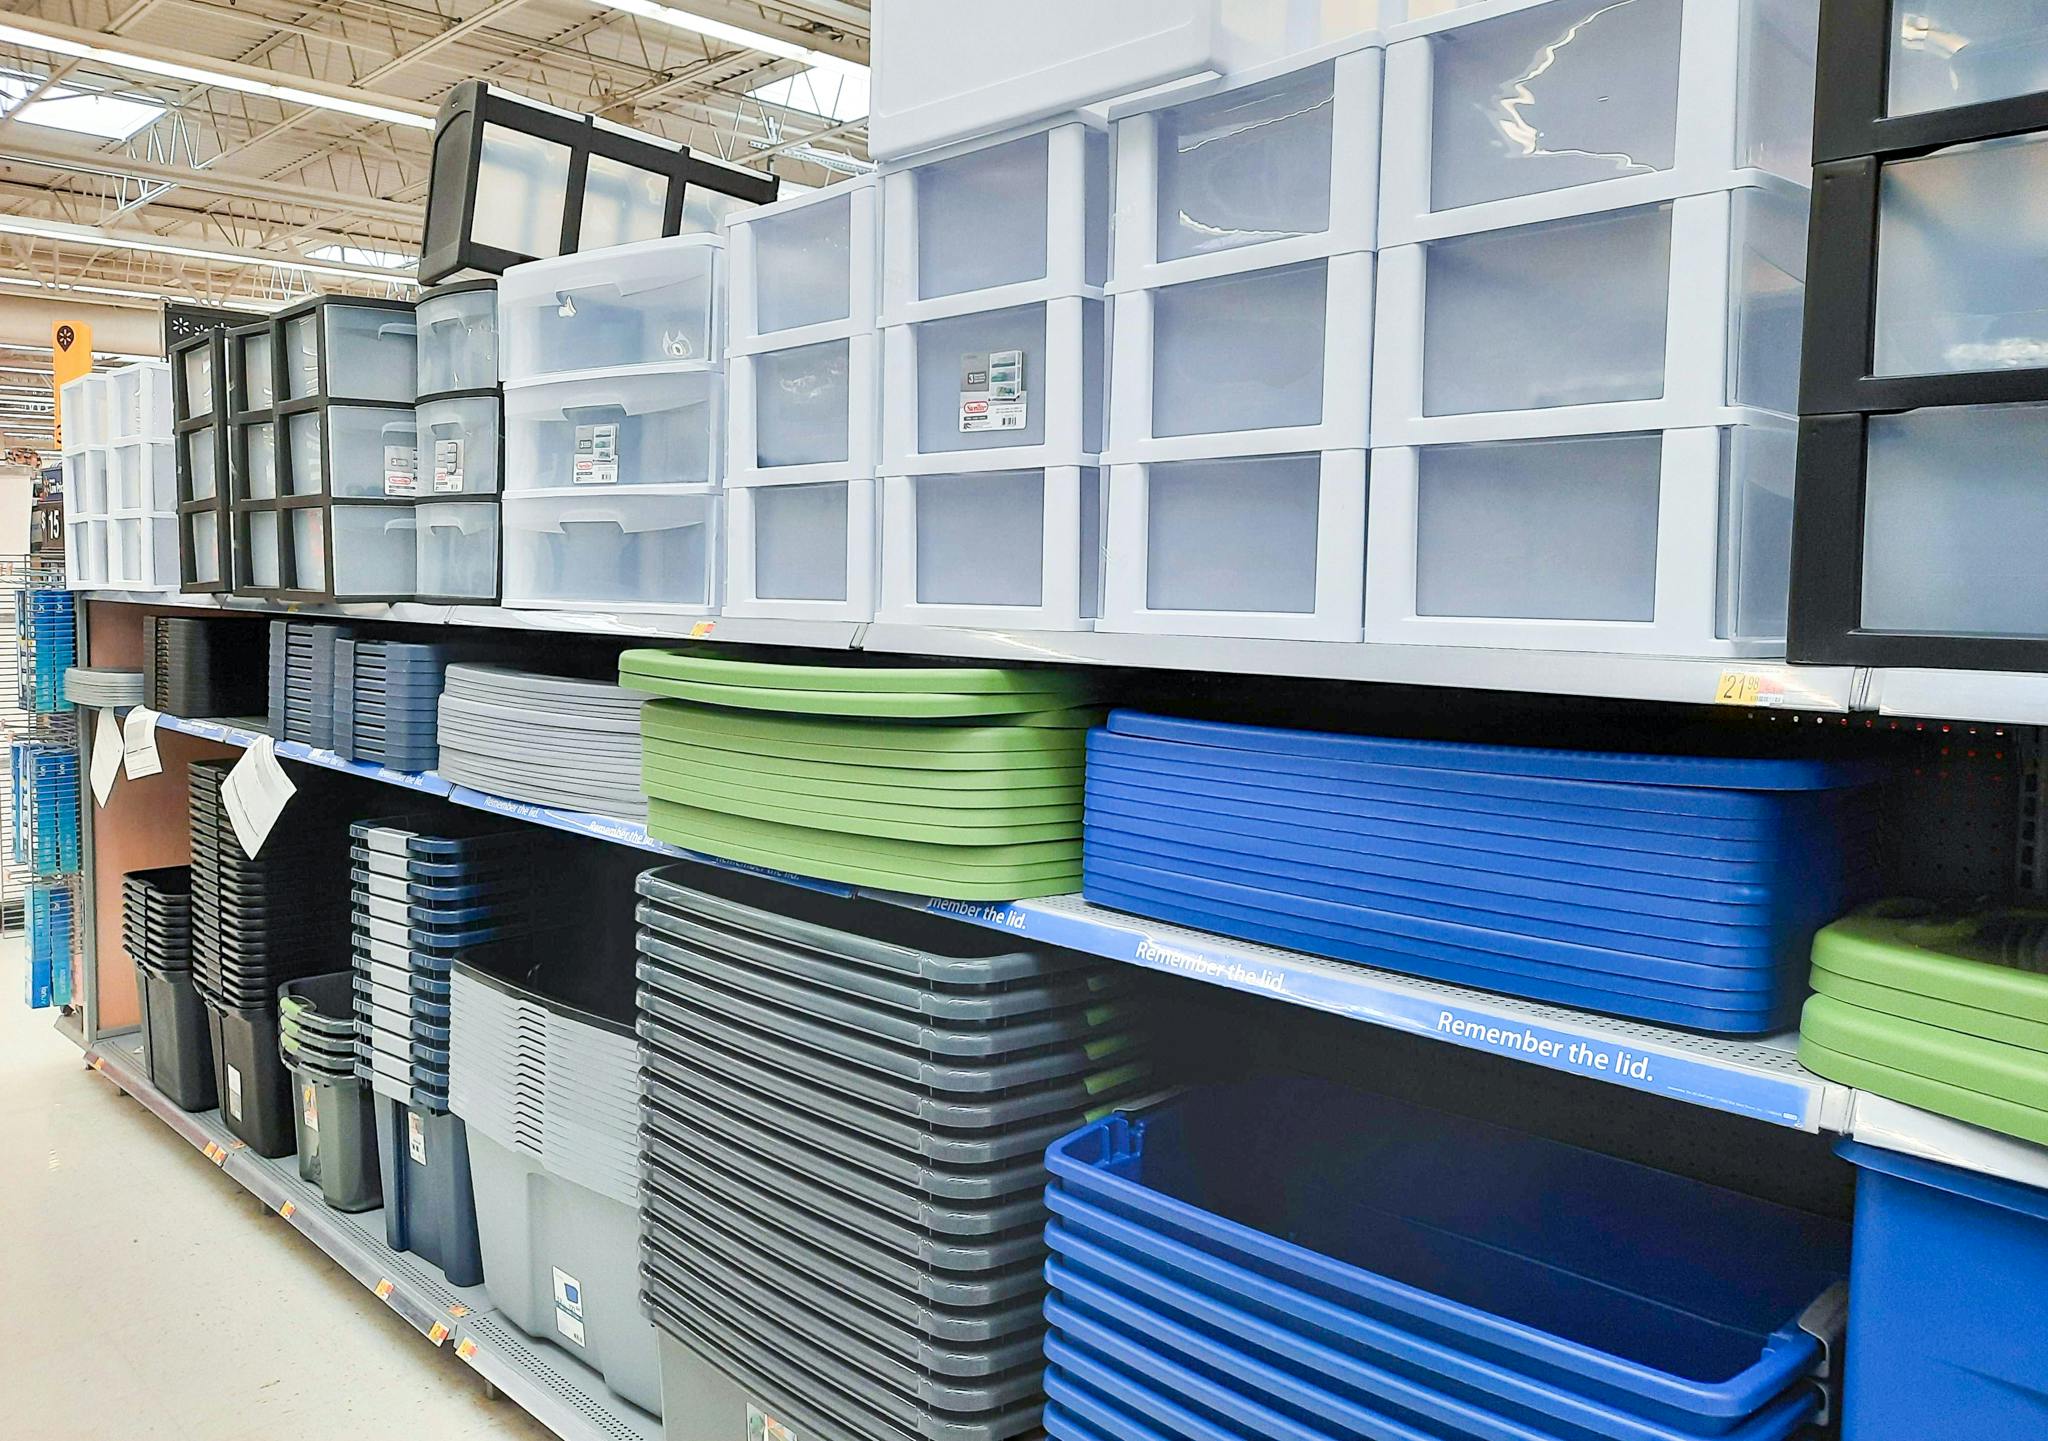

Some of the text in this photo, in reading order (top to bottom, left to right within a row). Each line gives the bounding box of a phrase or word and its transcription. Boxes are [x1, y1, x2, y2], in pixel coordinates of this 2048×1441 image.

[49, 509, 60, 540] 15
[1723, 674, 1746, 700] 21
[484, 796, 517, 814] Remember
[517, 803, 529, 816] the
[588, 821, 629, 840] Remember
[927, 897, 1026, 930] member the lid.
[1135, 941, 1227, 977] Remember
[1227, 963, 1258, 984] the
[1437, 1011, 1654, 1082] Remember the lid.
